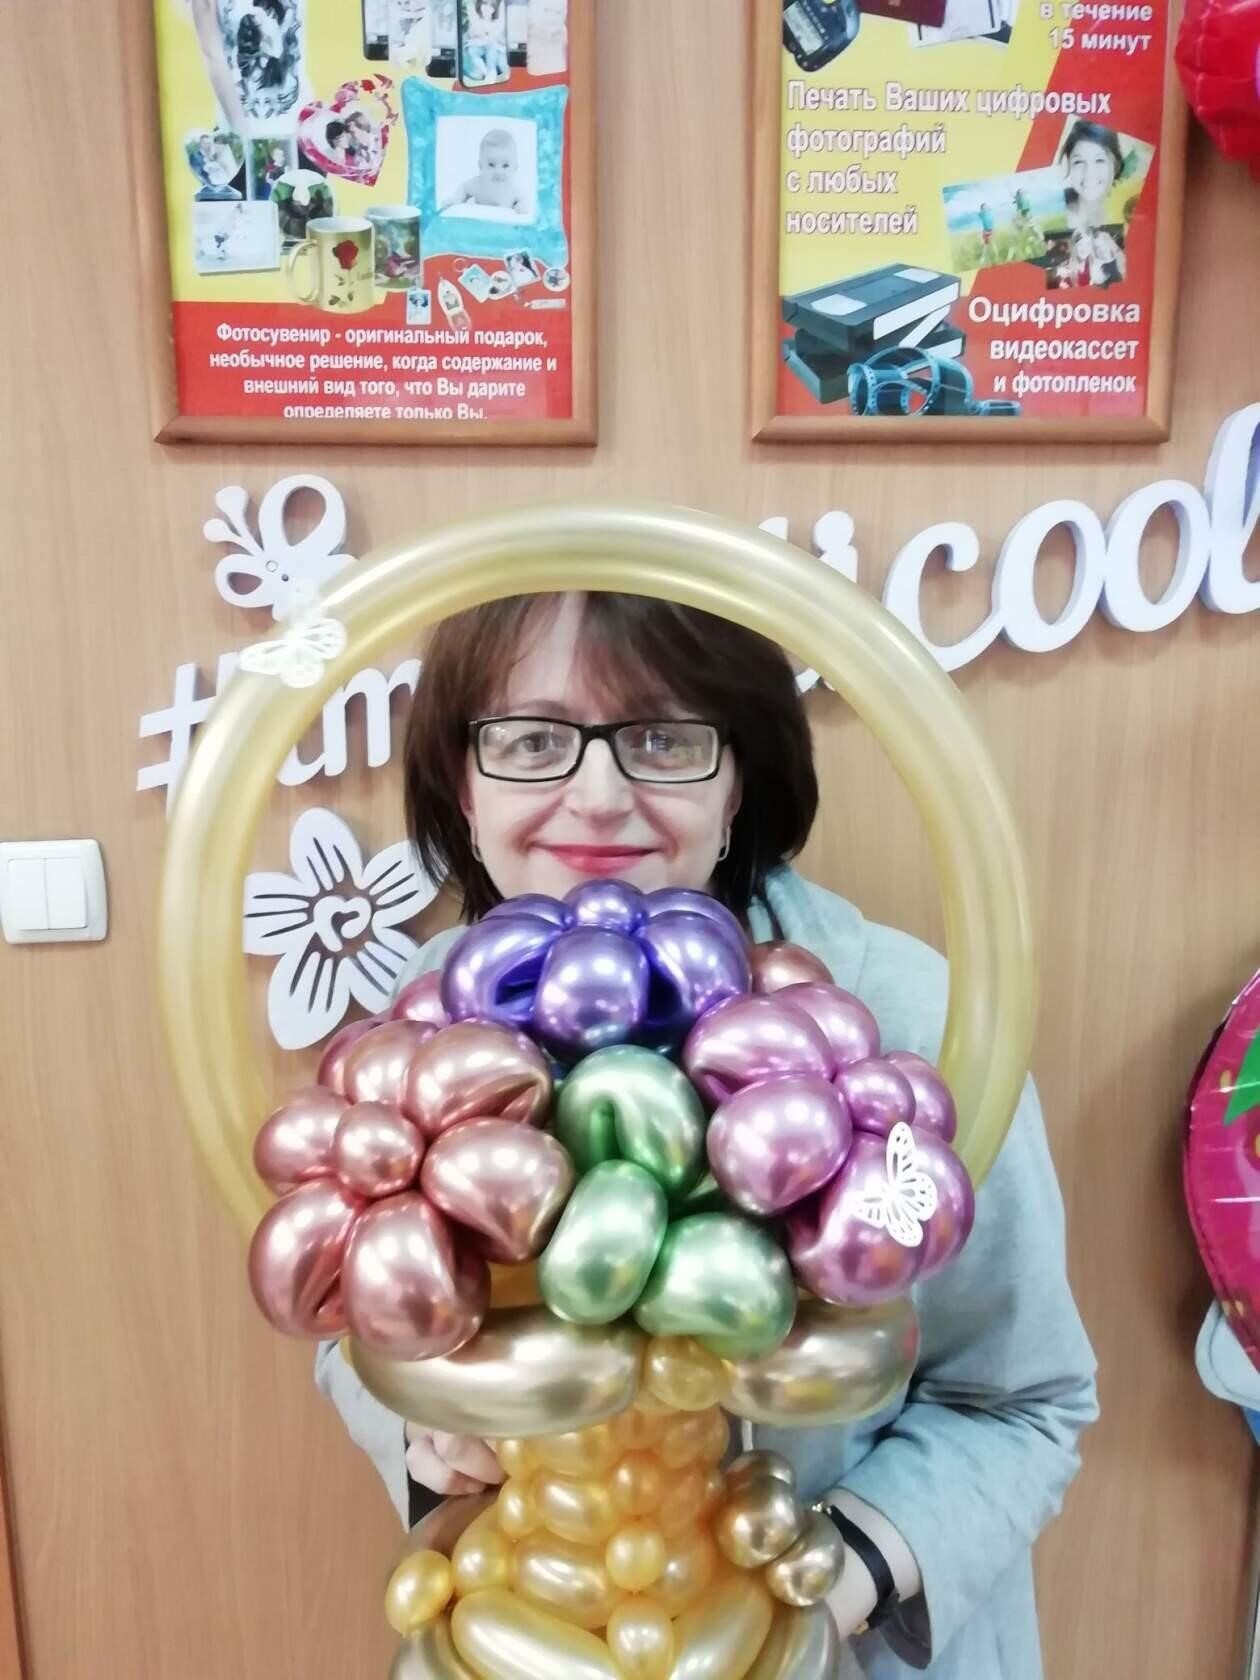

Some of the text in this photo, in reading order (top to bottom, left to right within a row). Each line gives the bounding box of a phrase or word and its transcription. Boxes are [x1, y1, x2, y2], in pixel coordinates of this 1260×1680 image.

[1040, 2, 1153, 21] в течение
[1049, 27, 1152, 56] 15 минут
[787, 80, 1111, 119] Печать Ваших цифровых
[786, 123, 946, 158] фотографий
[786, 164, 898, 194] с любых
[786, 208, 919, 235] носителей
[968, 296, 1141, 328] Оцифровка
[216, 323, 331, 348] Фотосувенир
[345, 325, 470, 347] оригинальный
[474, 330, 548, 348] подарок,
[209, 350, 557, 372] необычное решение, когда содержание и
[989, 338, 1140, 361] видеокассет
[243, 376, 526, 399] внешний вид того, что Вы дарите
[993, 370, 1136, 397] и фотопленок
[283, 405, 391, 419] определяете
[395, 406, 453, 419] только
